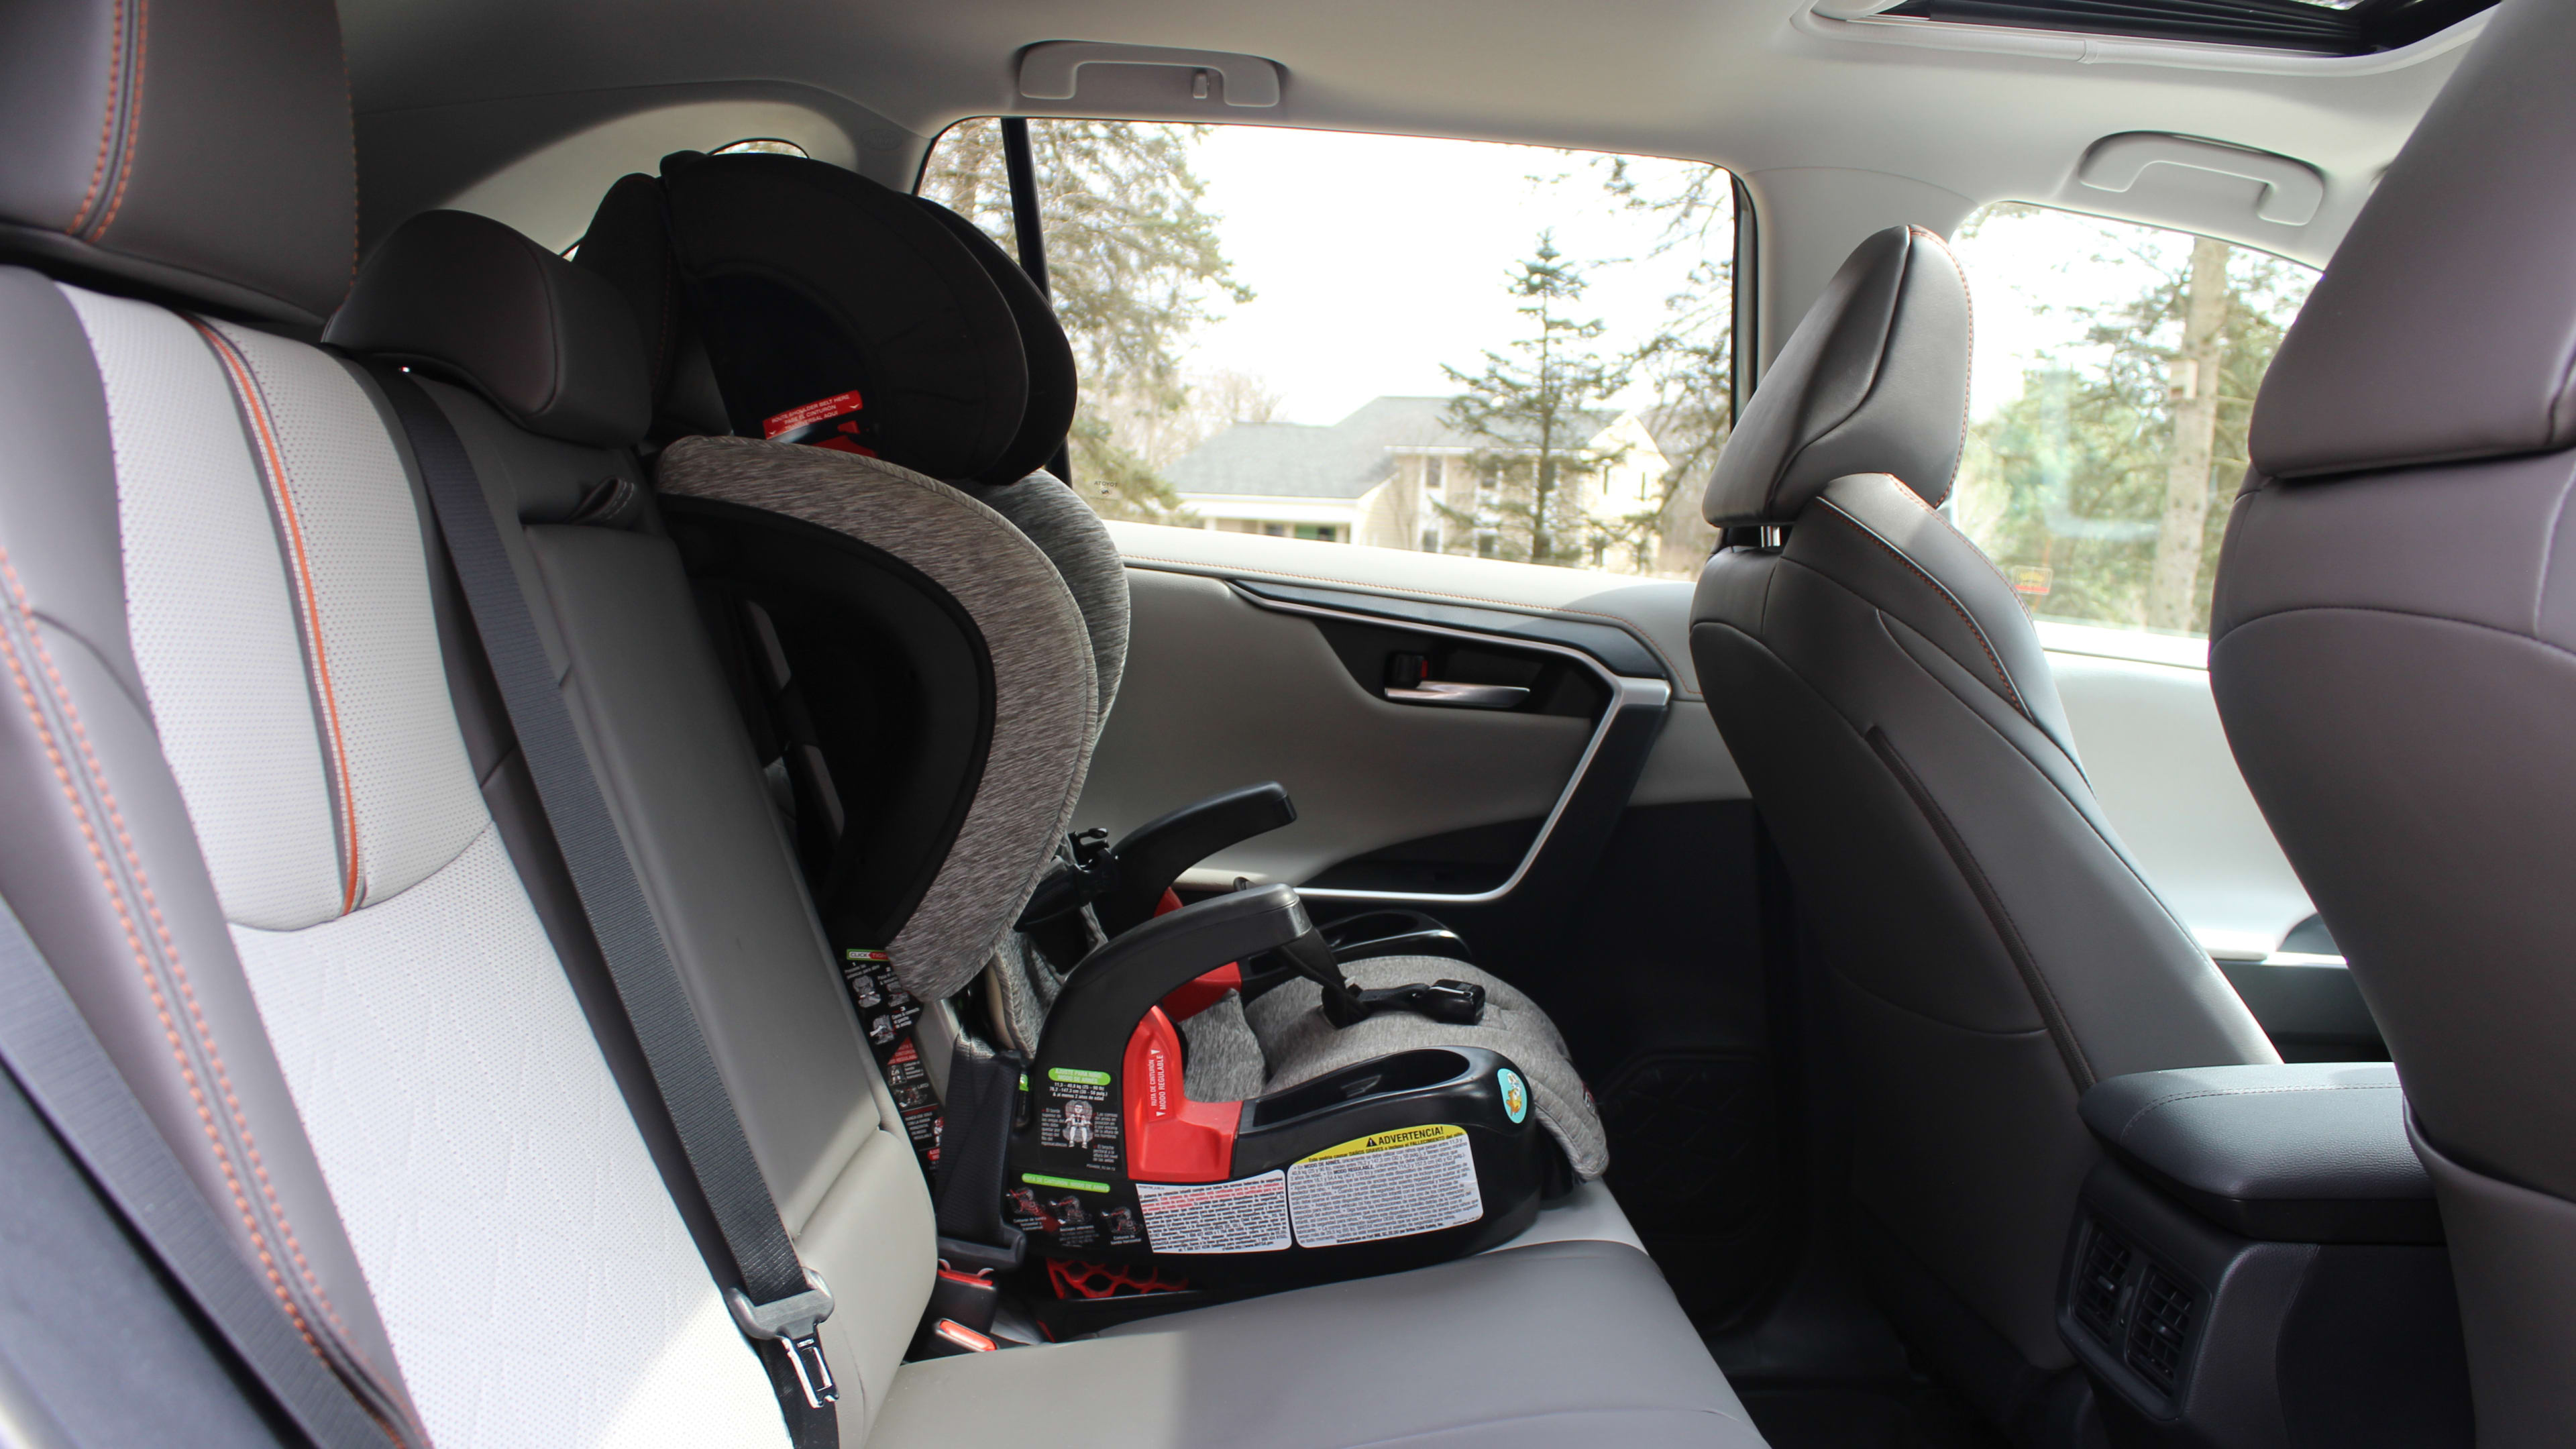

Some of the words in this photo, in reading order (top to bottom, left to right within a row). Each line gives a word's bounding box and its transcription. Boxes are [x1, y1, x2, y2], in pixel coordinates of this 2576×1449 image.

[1157, 1055, 1166, 1090] REGULABLE
[1159, 1091, 1167, 1110] MODO
[1379, 1127, 1444, 1145] ADVERTENCIA!
